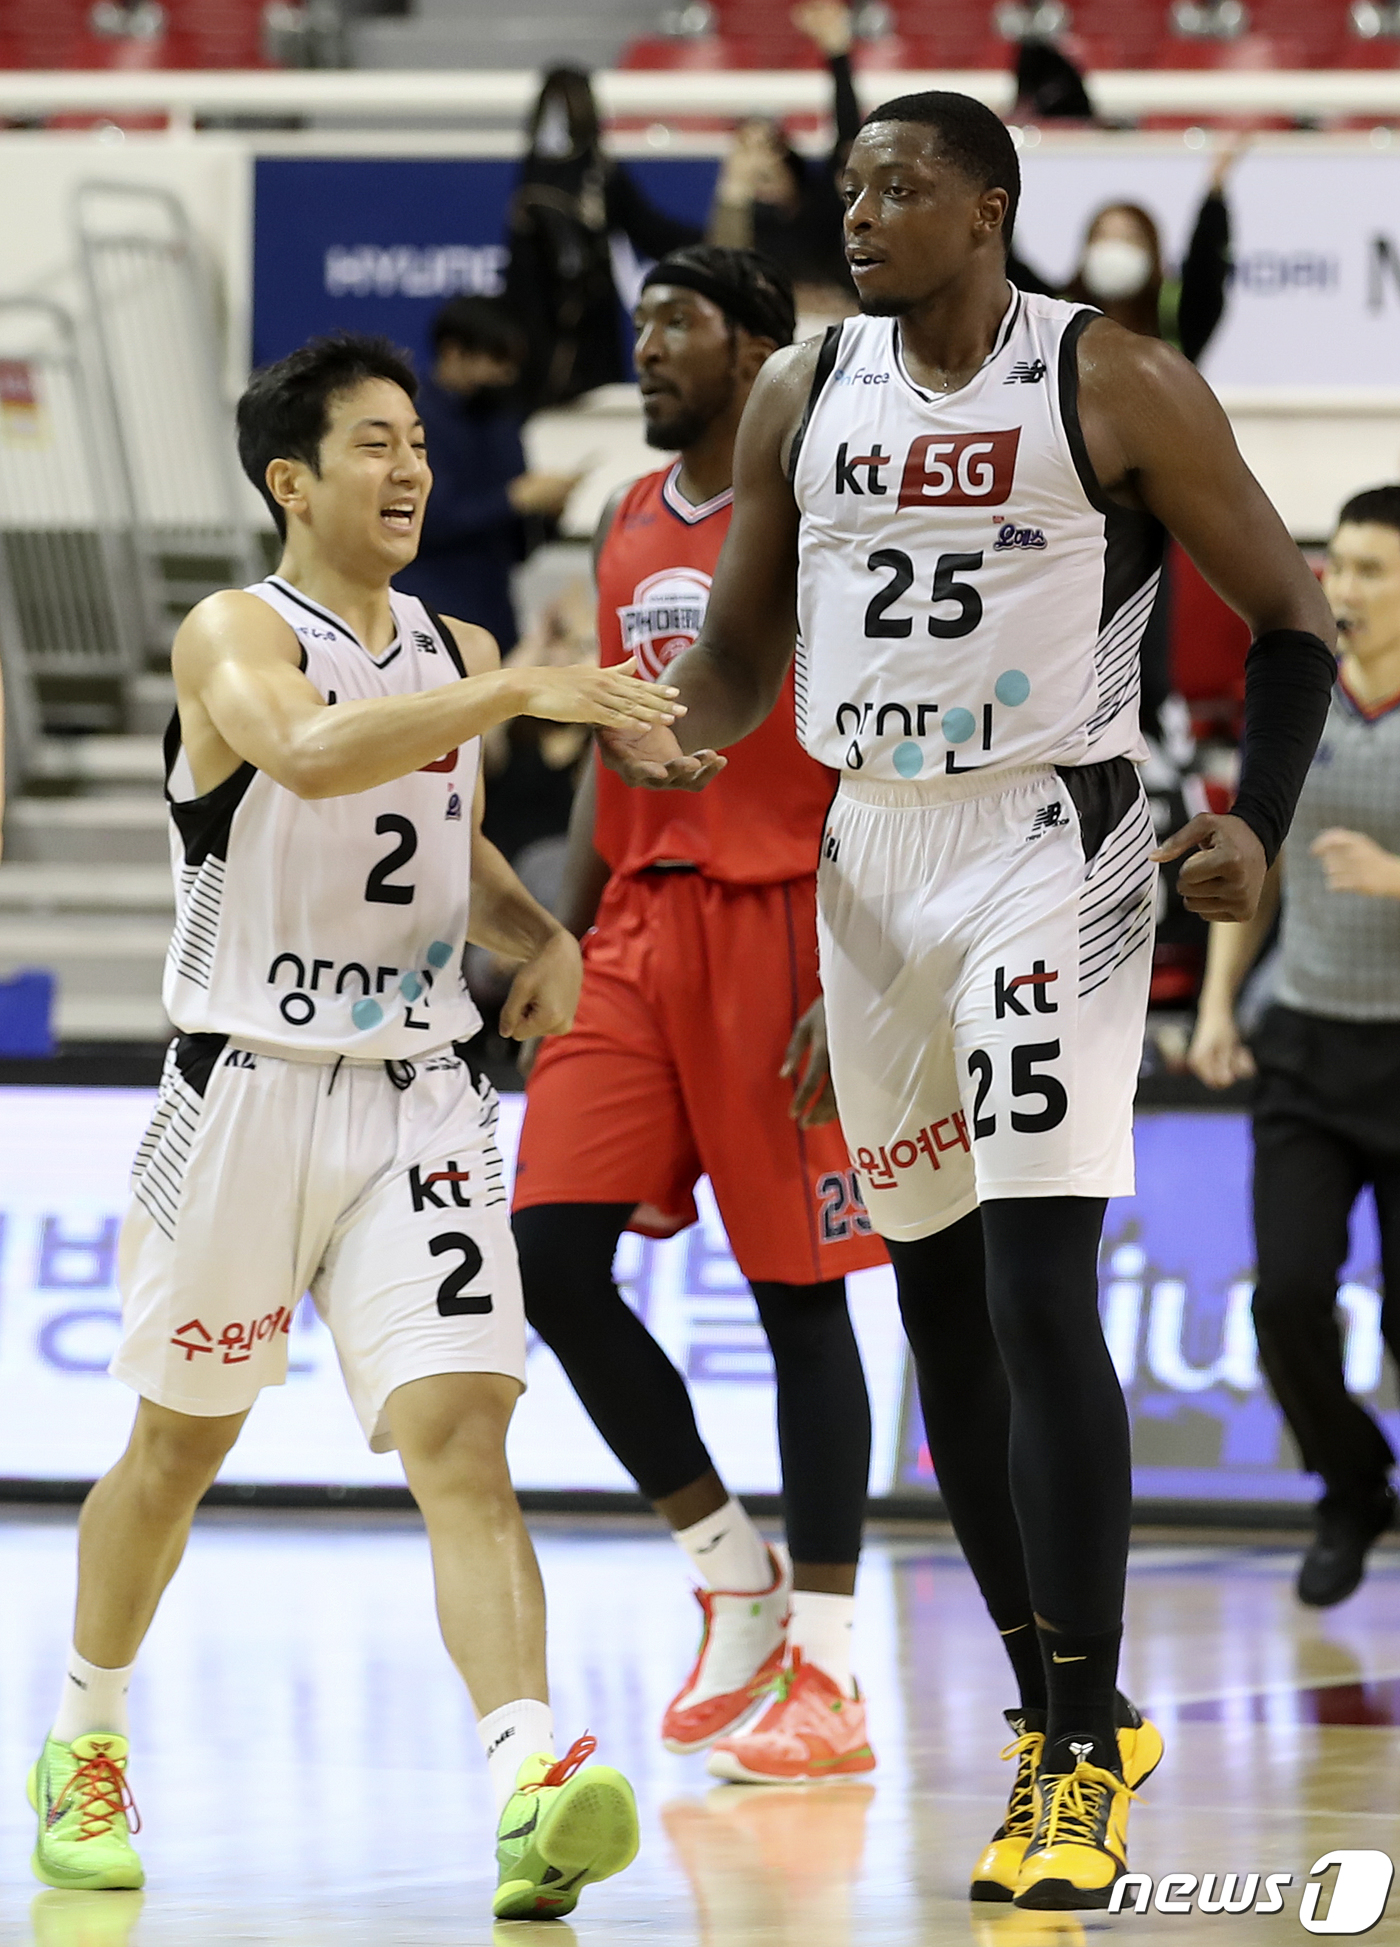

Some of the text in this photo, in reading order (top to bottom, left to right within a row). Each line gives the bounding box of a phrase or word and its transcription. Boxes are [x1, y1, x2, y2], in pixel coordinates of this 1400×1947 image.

[835, 442, 995, 497] kt 5G
[864, 548, 984, 639] 25
[365, 813, 418, 905] 2
[994, 959, 1058, 1020] kt
[967, 1037, 1068, 1141] 25
[409, 1160, 471, 1212] kt
[851, 1108, 971, 1189] 원여대
[428, 1231, 493, 1316] 2
